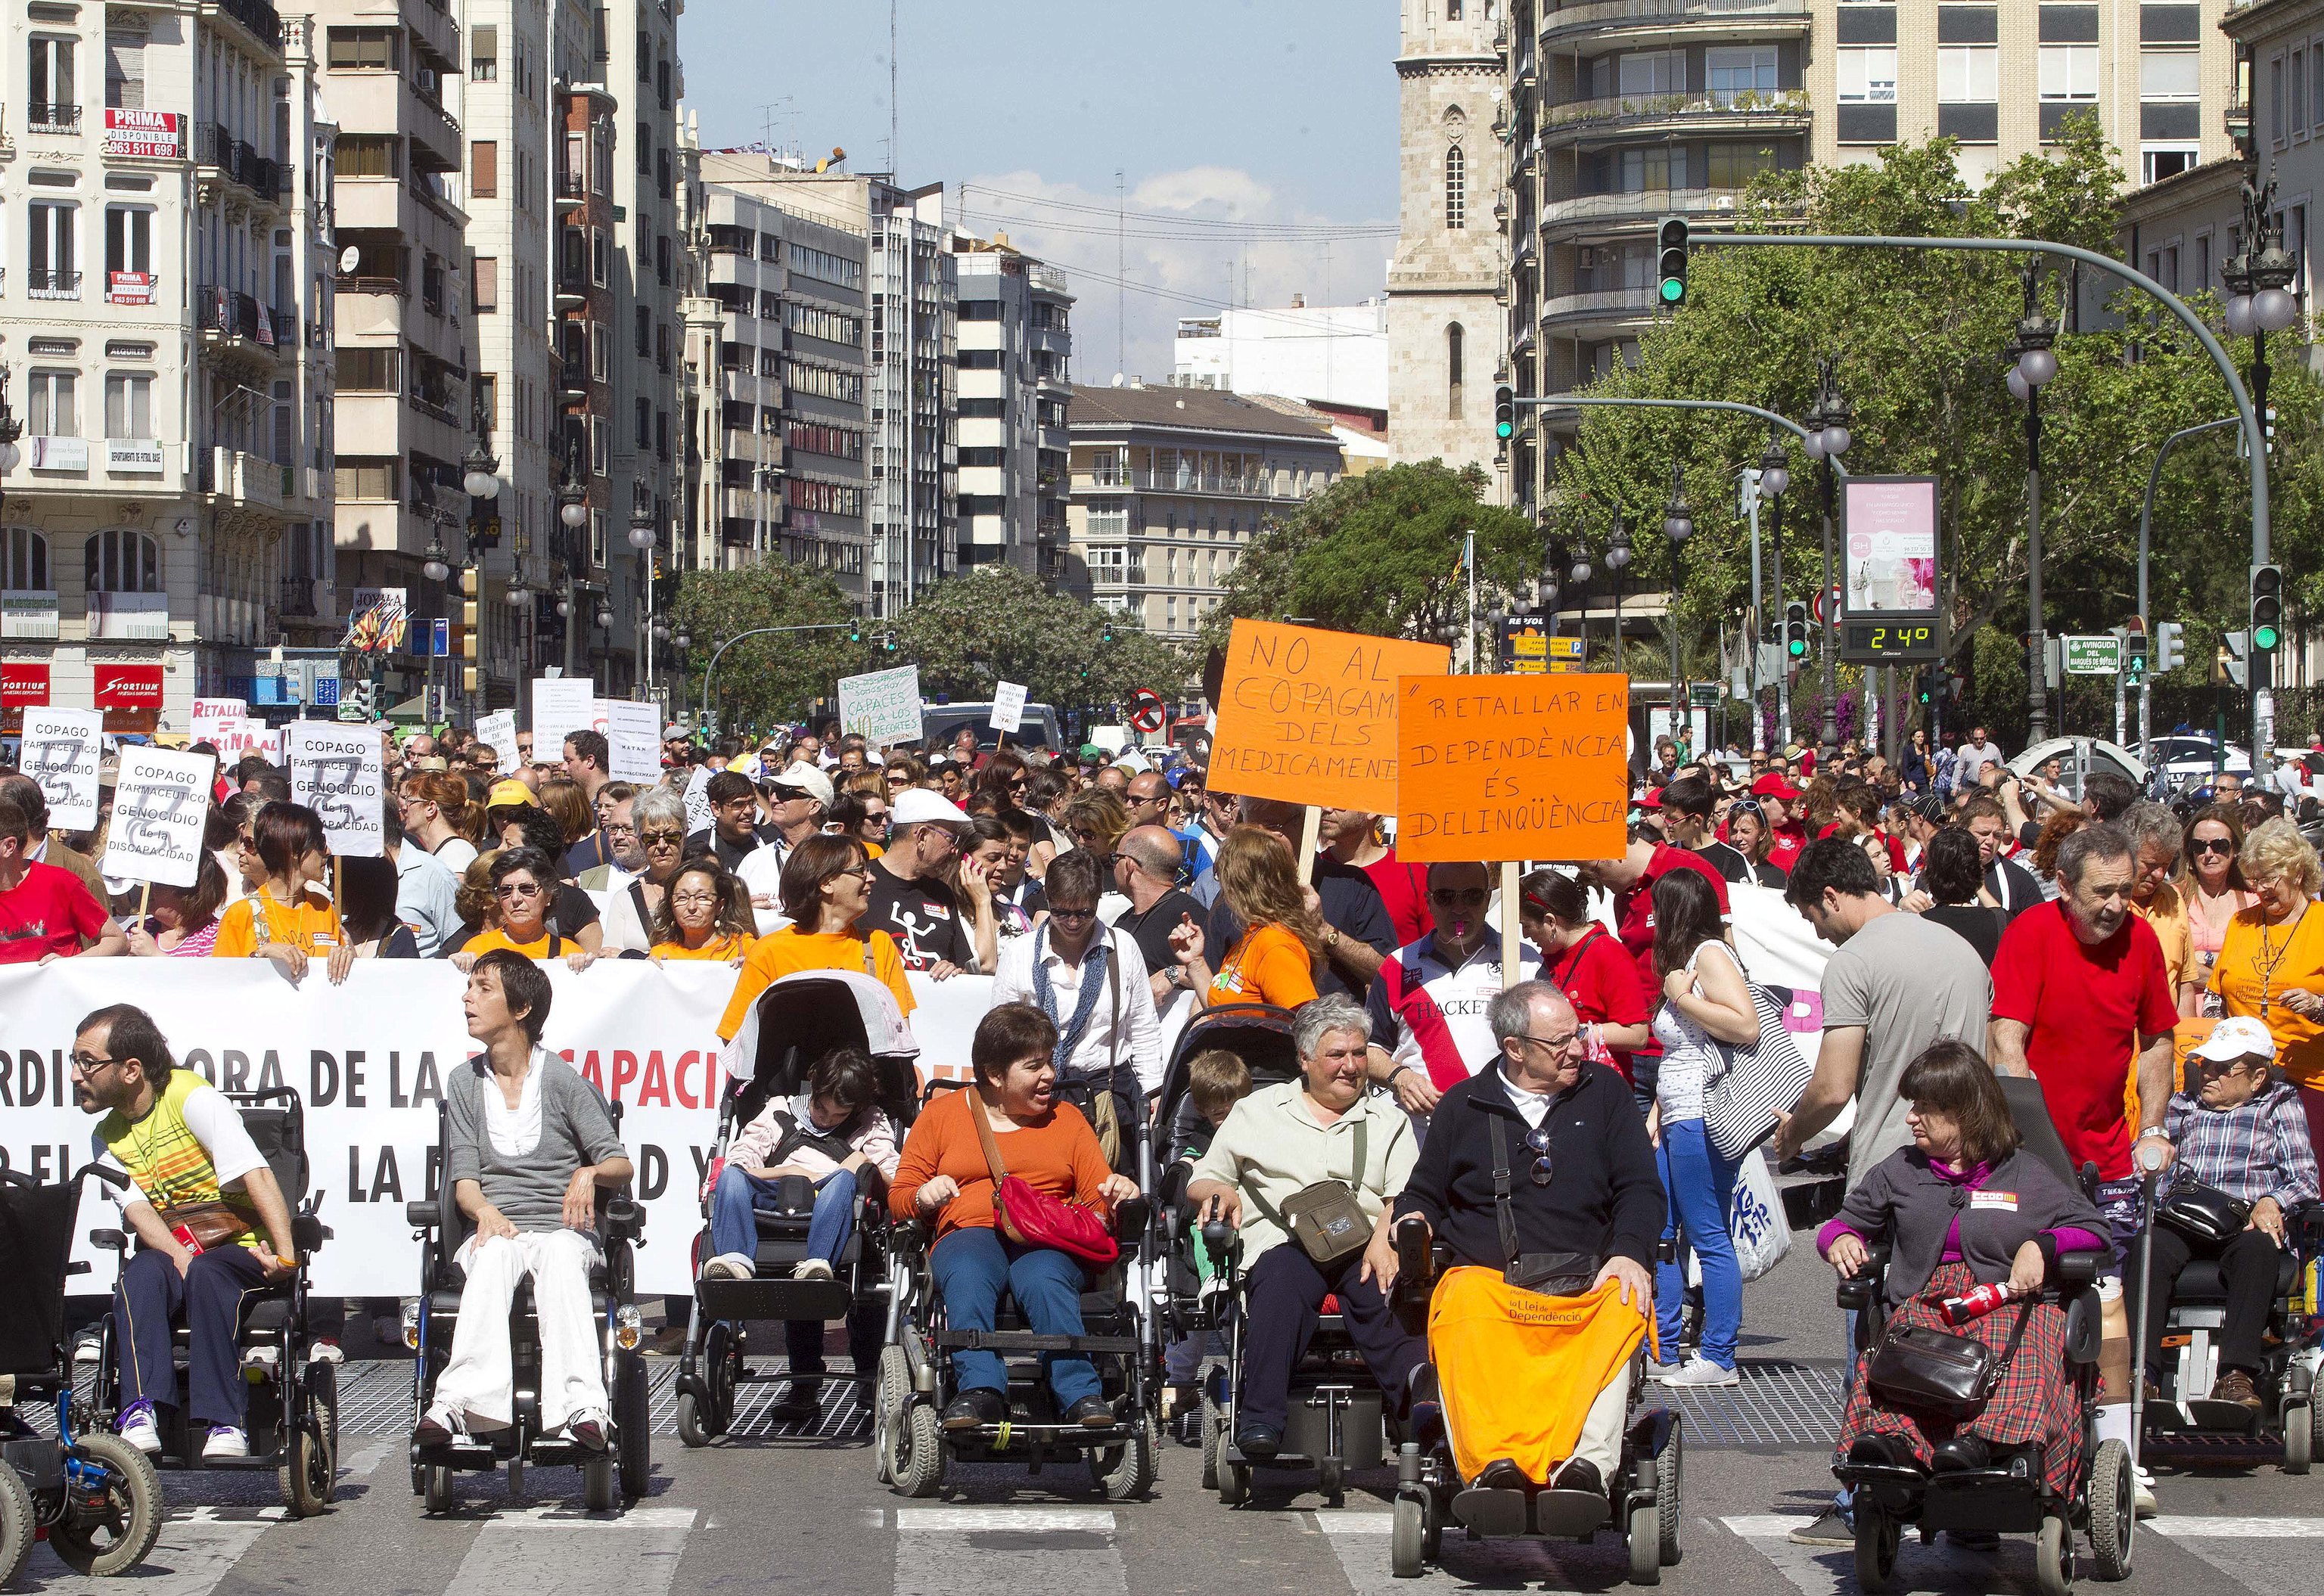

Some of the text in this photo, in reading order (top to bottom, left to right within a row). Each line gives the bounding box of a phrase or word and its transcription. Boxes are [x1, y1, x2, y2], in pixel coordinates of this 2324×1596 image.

[114, 110, 165, 126] PRIMA
[111, 130, 172, 142] DISPONIBLE
[110, 141, 172, 156] 963 511 698
[39, 344, 66, 352] VENTA
[111, 452, 135, 461] DEPARTAMENTO
[135, 452, 140, 462] DE
[1853, 542, 1869, 550] SH
[1574, 642, 1581, 654] P
[1251, 635, 1389, 682] NO AL
[2070, 657, 2092, 666] MARQUÉS
[98, 677, 159, 694] SPORTIUM
[844, 681, 859, 690] LOS
[855, 686, 882, 696] SOMOS
[847, 692, 906, 716] CAPACES
[1596, 691, 1625, 713] EN
[480, 721, 511, 735] DERECHO
[489, 716, 499, 725] UN
[847, 707, 910, 740] NO A LOS
[874, 719, 919, 737] RECORTES
[36, 724, 89, 737] COPAGO
[492, 731, 501, 740] DE
[1276, 722, 1372, 746] DELS
[23, 739, 98, 755] FARMACÉUTICO
[260, 739, 278, 751] AL
[305, 741, 365, 754] COPAGO
[1412, 726, 1625, 767] DEPENDÈNCIA
[24, 760, 94, 775] GENOCIDIO
[294, 759, 378, 773] FARMACÉUTICO
[135, 765, 197, 784] COPAGO
[45, 781, 70, 790] de la
[297, 781, 375, 796] GENOCIDIO
[1486, 769, 1520, 799] ÉS
[119, 782, 206, 804] FARMACÉUTICO
[685, 788, 698, 806] UN
[117, 804, 198, 827] GENOCIDIO
[322, 803, 350, 813] de la
[1409, 794, 1626, 839] DELINQÜÈNCIA
[139, 828, 168, 840] de la
[109, 841, 194, 862] DISCAPACIDAD
[310, 1050, 367, 1108] DE
[390, 1051, 444, 1108] LA
[349, 1145, 403, 1203] LA
[1973, 1192, 2003, 1201] CCOO
[1518, 1300, 1538, 1311] Llei
[1509, 1309, 1581, 1323] Dependència
